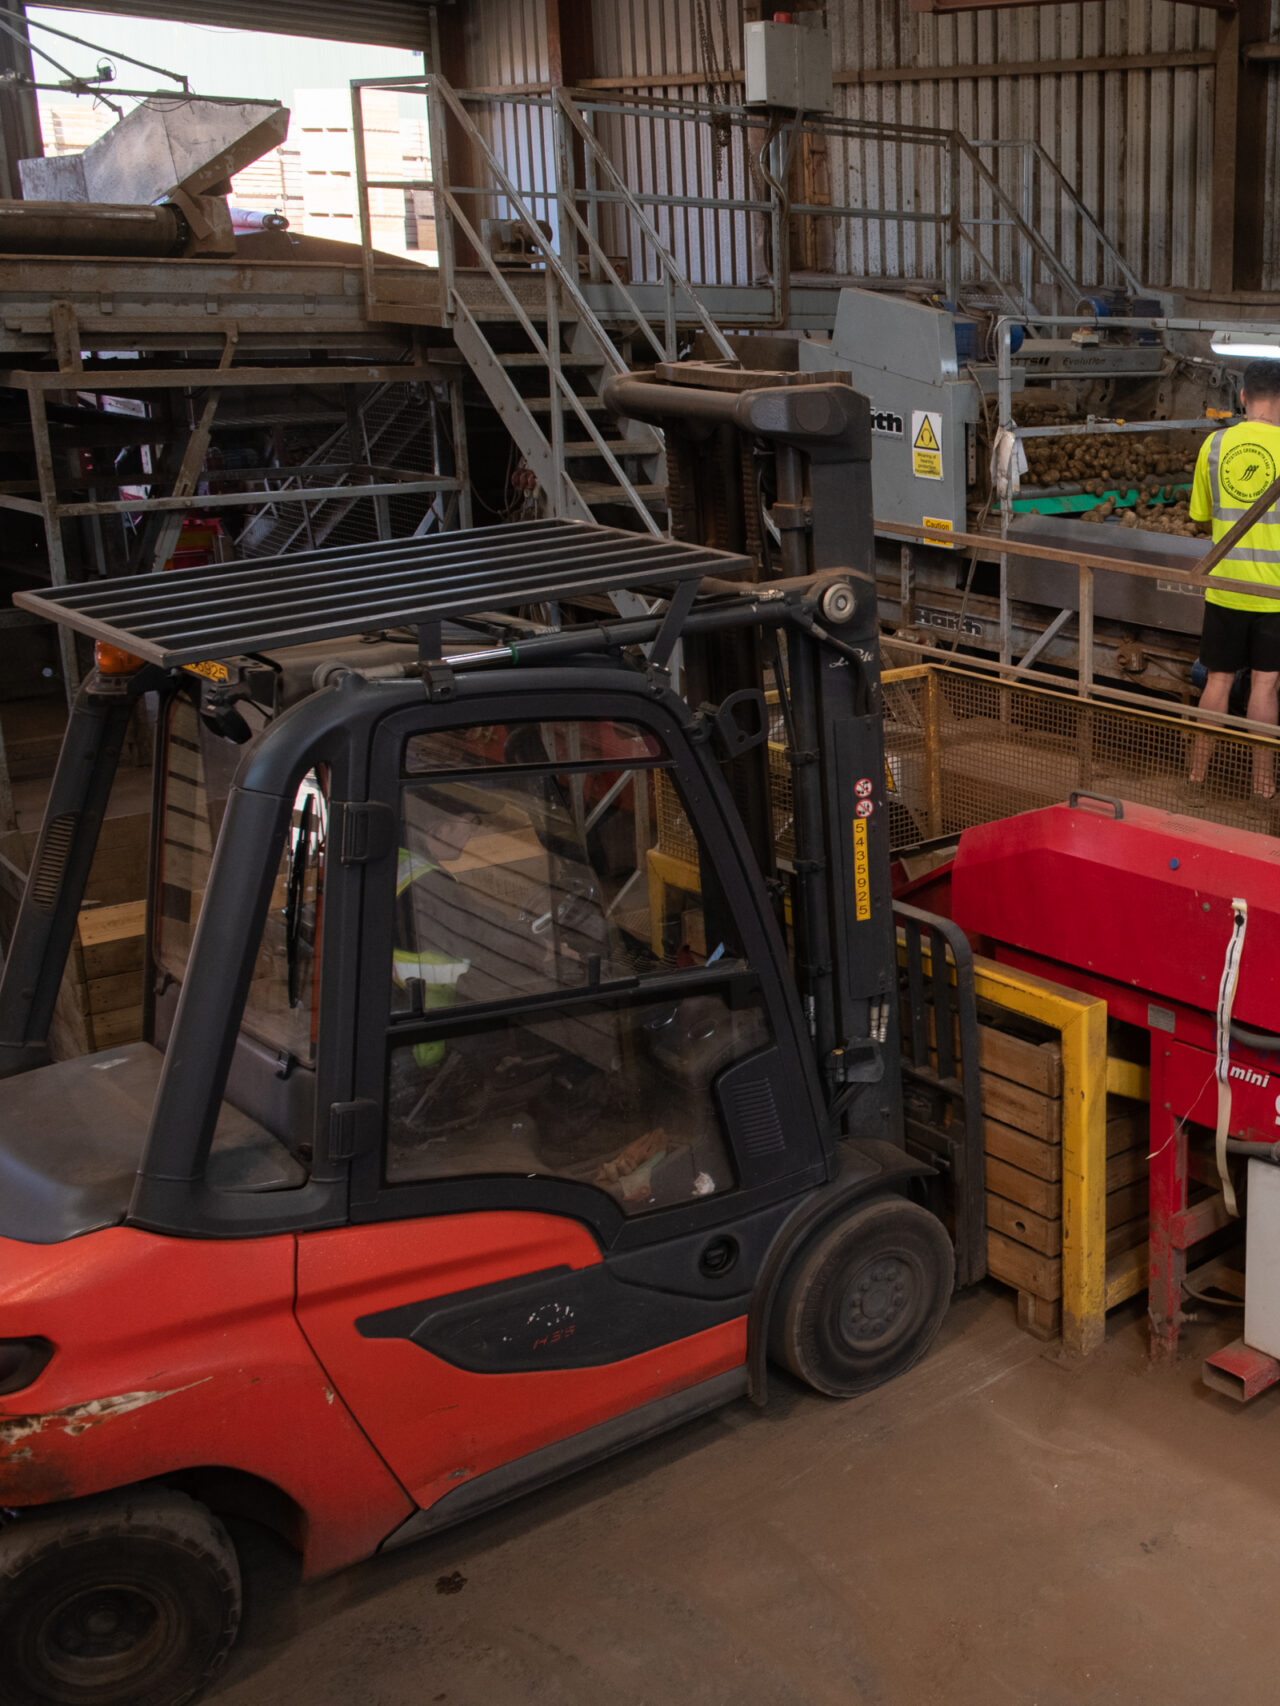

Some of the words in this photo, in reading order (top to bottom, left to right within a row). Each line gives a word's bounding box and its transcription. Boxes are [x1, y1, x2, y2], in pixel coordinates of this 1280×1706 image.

[870, 407, 904, 435] ith
[925, 519, 950, 531] Caution
[1230, 1066, 1270, 1088] mini
